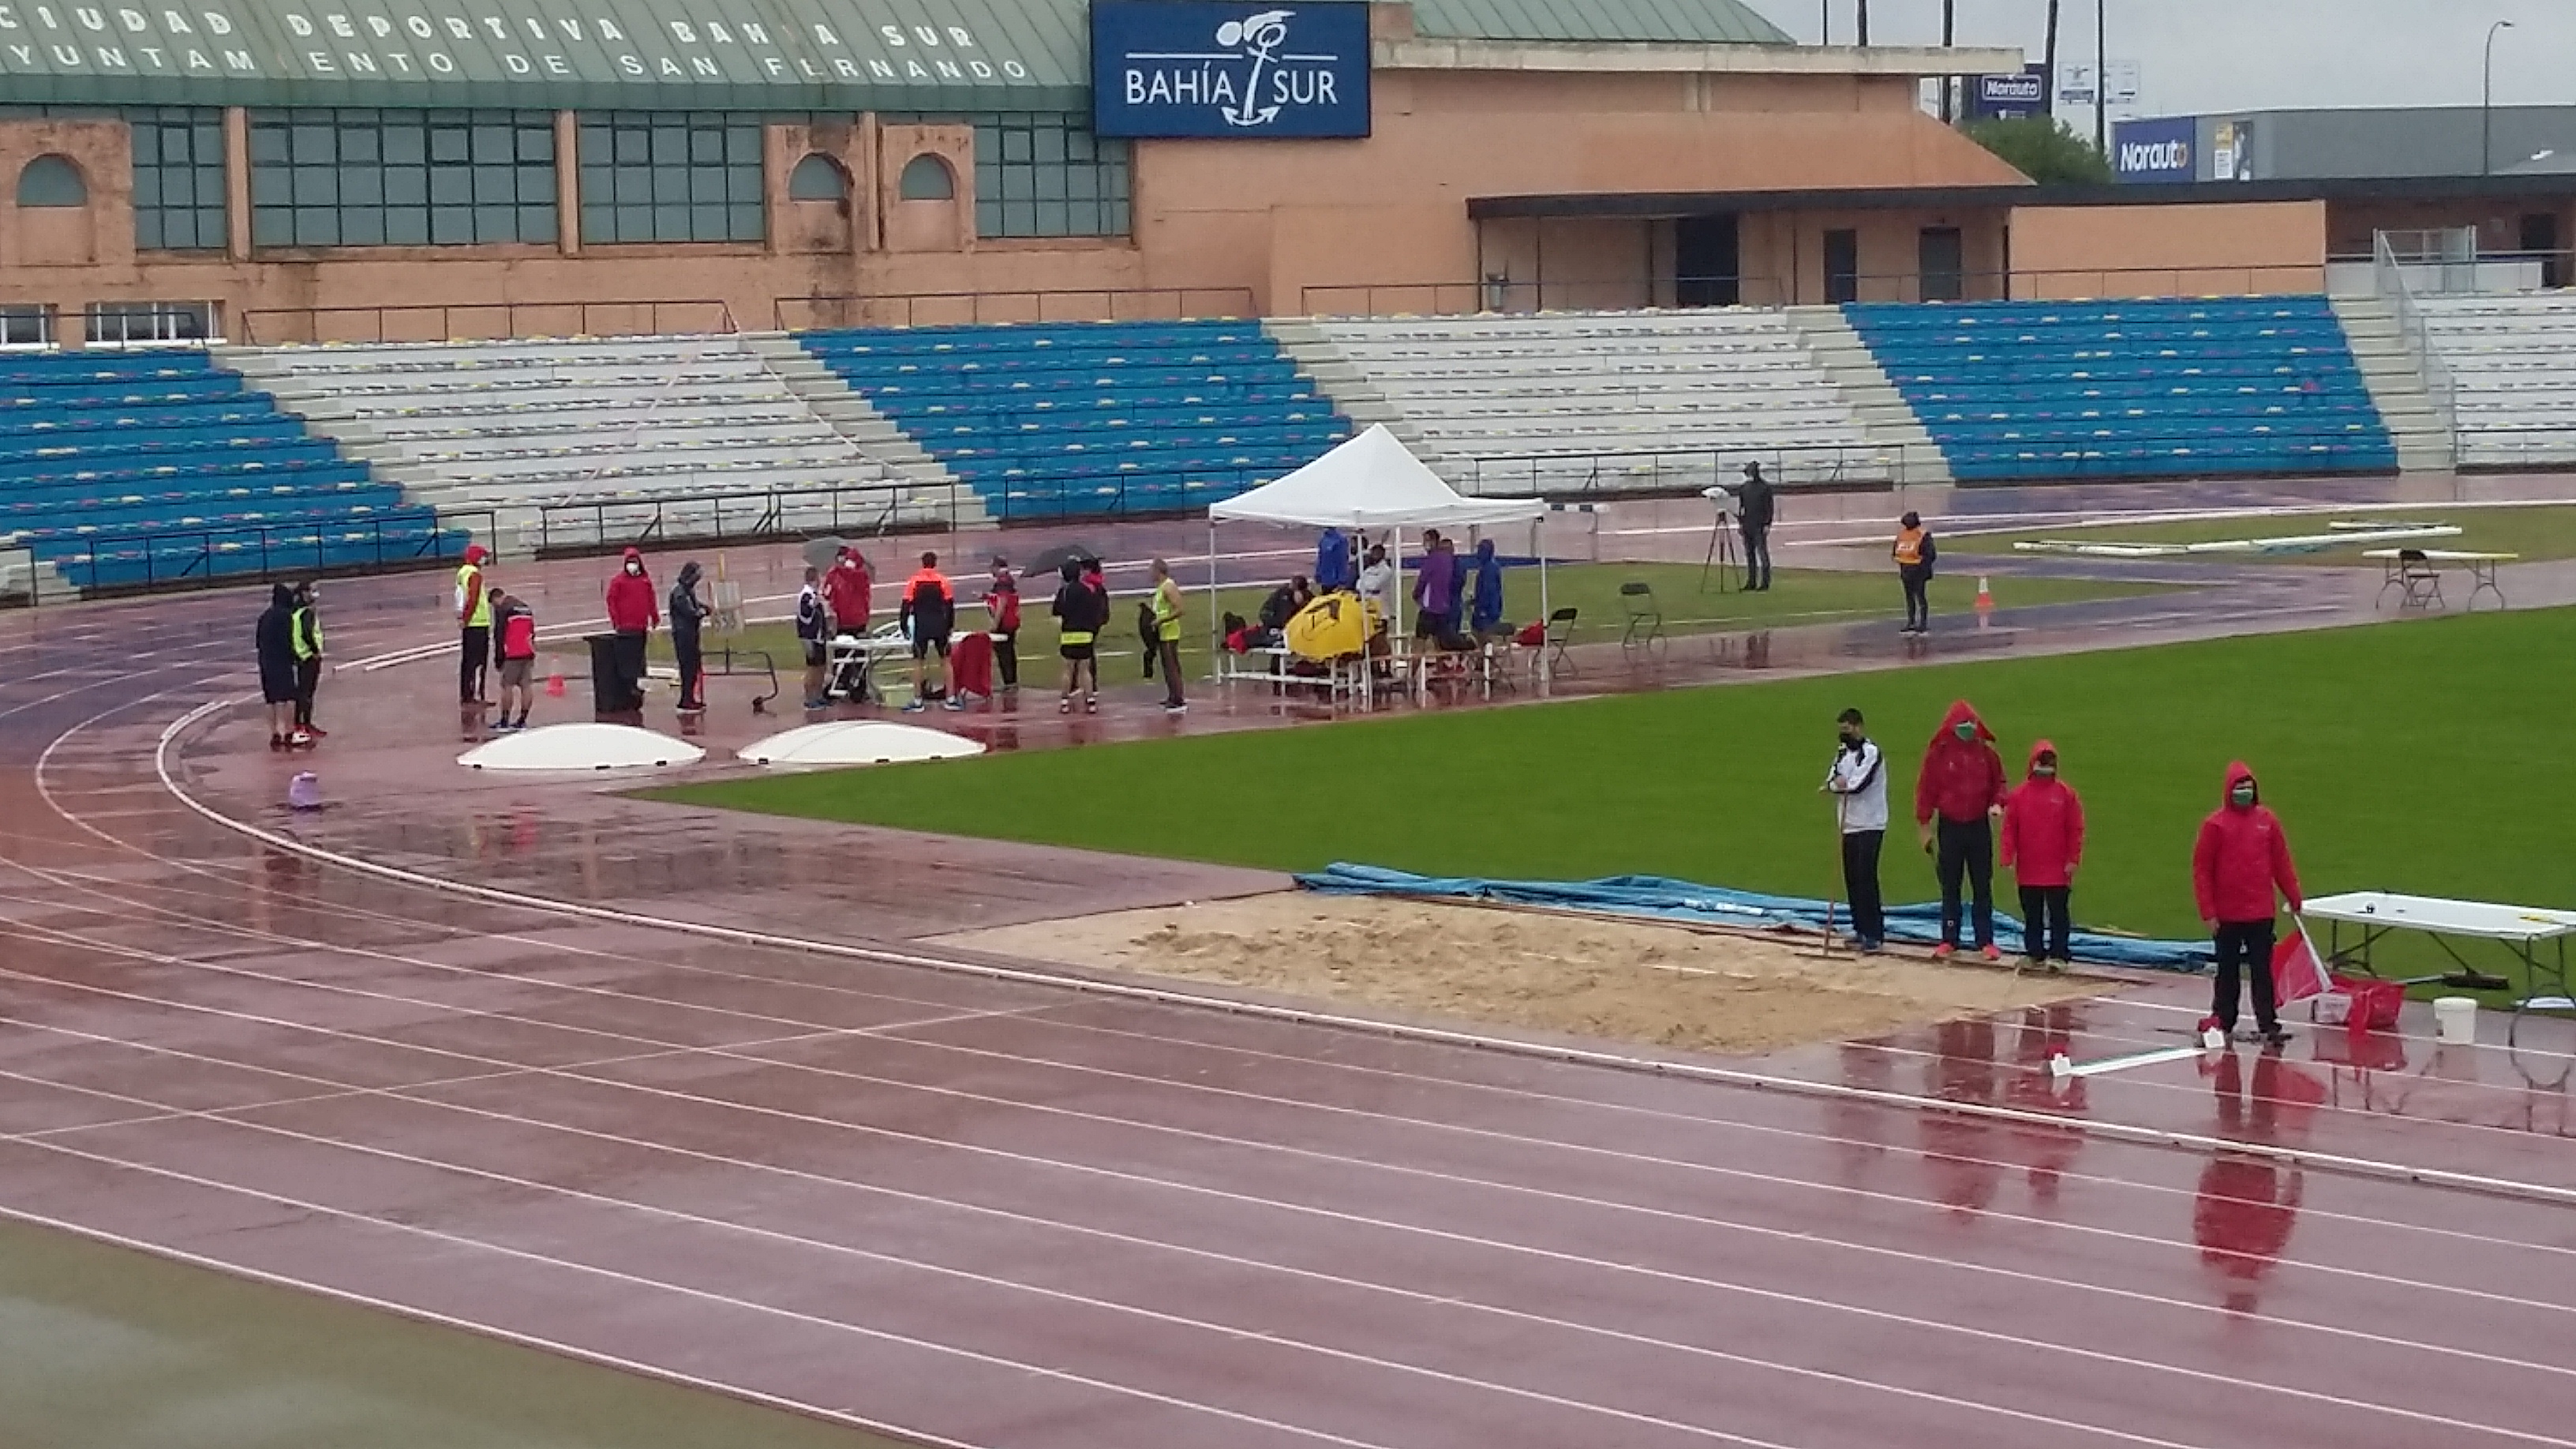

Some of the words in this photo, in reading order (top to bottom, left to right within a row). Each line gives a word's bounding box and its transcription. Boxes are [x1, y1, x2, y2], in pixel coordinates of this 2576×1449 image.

[0, 6, 232, 34] CIUDAD
[286, 13, 623, 40] DEPORTIVA
[671, 21, 839, 44] BAHA
[881, 25, 973, 46] SUR
[9, 44, 453, 72] YUNTAMENTO
[505, 54, 570, 74] DE
[620, 54, 719, 76] SAN
[1125, 61, 1237, 105] BAHÍA
[1272, 69, 1339, 105] SUR
[1986, 80, 2039, 96] Norauto
[2119, 139, 2187, 172] Norauto
